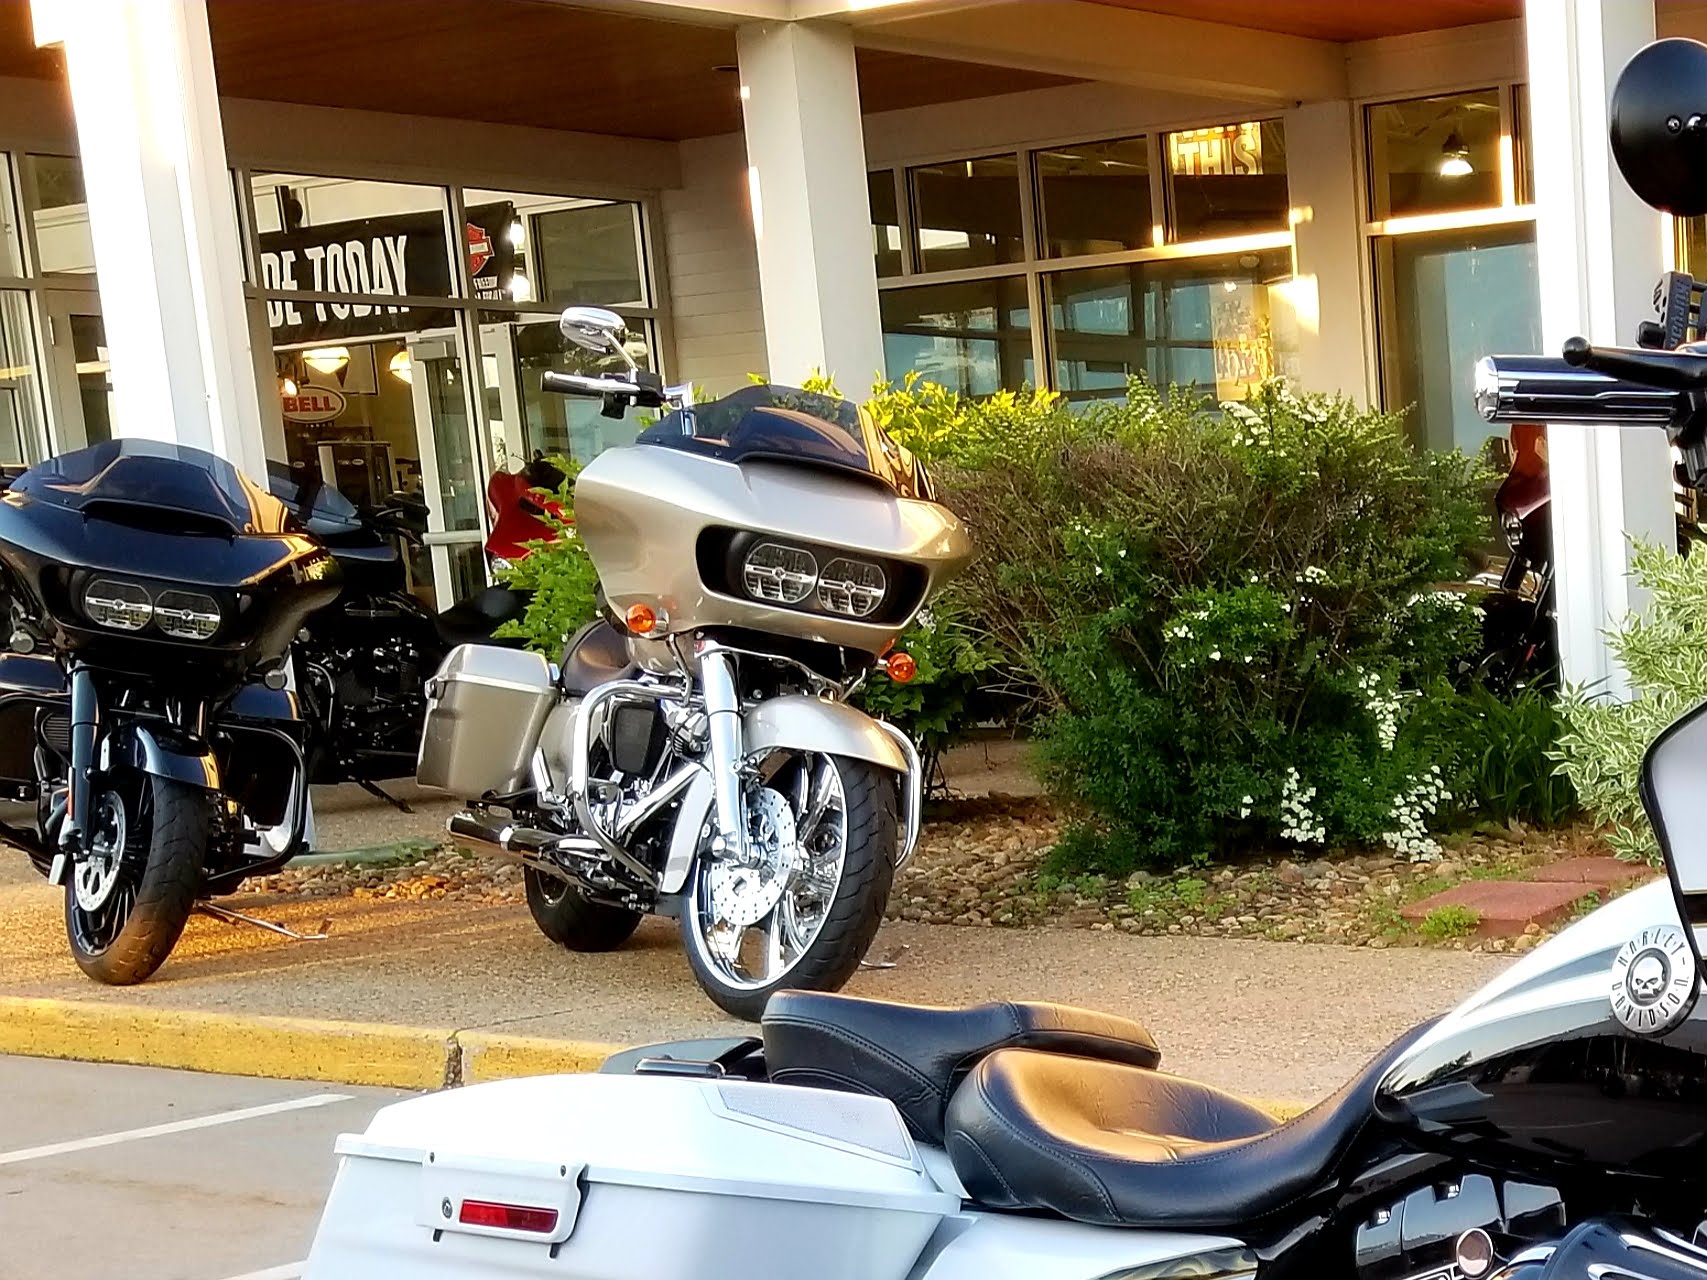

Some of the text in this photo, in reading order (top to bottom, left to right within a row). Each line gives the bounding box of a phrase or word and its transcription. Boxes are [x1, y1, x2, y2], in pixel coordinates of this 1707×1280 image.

[1178, 138, 1258, 176] THIS
[304, 235, 410, 322] TODAY
[282, 396, 337, 412] BELL
